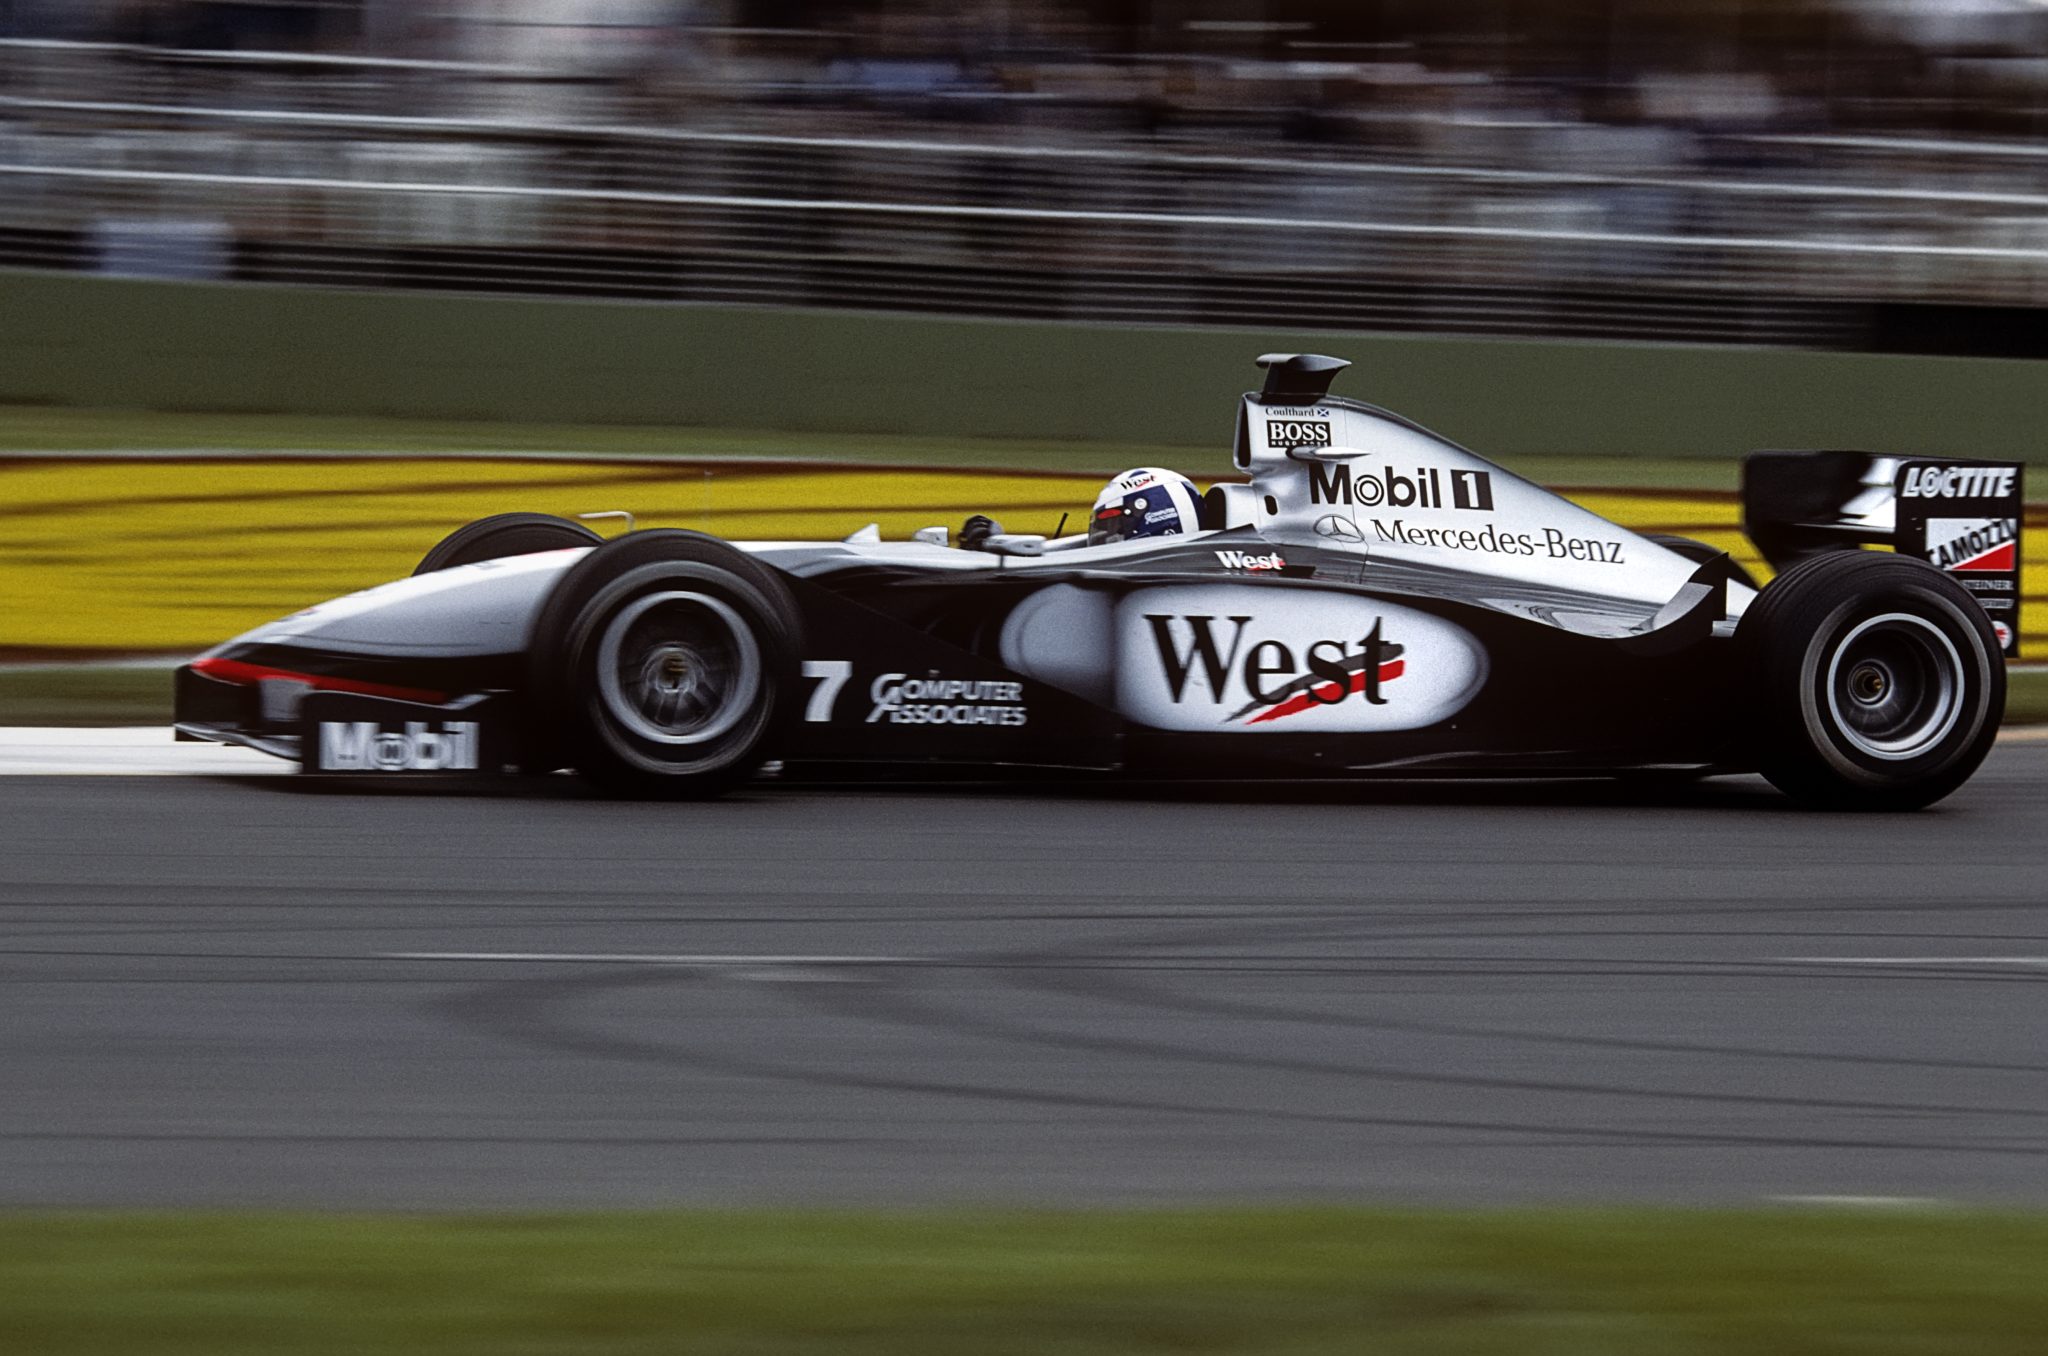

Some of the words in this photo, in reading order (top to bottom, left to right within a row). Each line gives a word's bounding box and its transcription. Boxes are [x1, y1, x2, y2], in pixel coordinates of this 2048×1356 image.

[1265, 407, 1315, 417] Coulthard
[1269, 422, 1328, 441] BOSS
[1120, 475, 1155, 490] West
[1308, 463, 1441, 509] Mobil
[1902, 466, 2017, 498] LOCTITE
[1370, 518, 1625, 564] Mercedes-Benz
[1215, 551, 1285, 570] West
[1143, 614, 1391, 705] West
[801, 660, 852, 722] 7
[870, 673, 1023, 704] COMPUTER
[865, 691, 1028, 726] ASSOCIATES
[319, 721, 480, 770] Mobil
